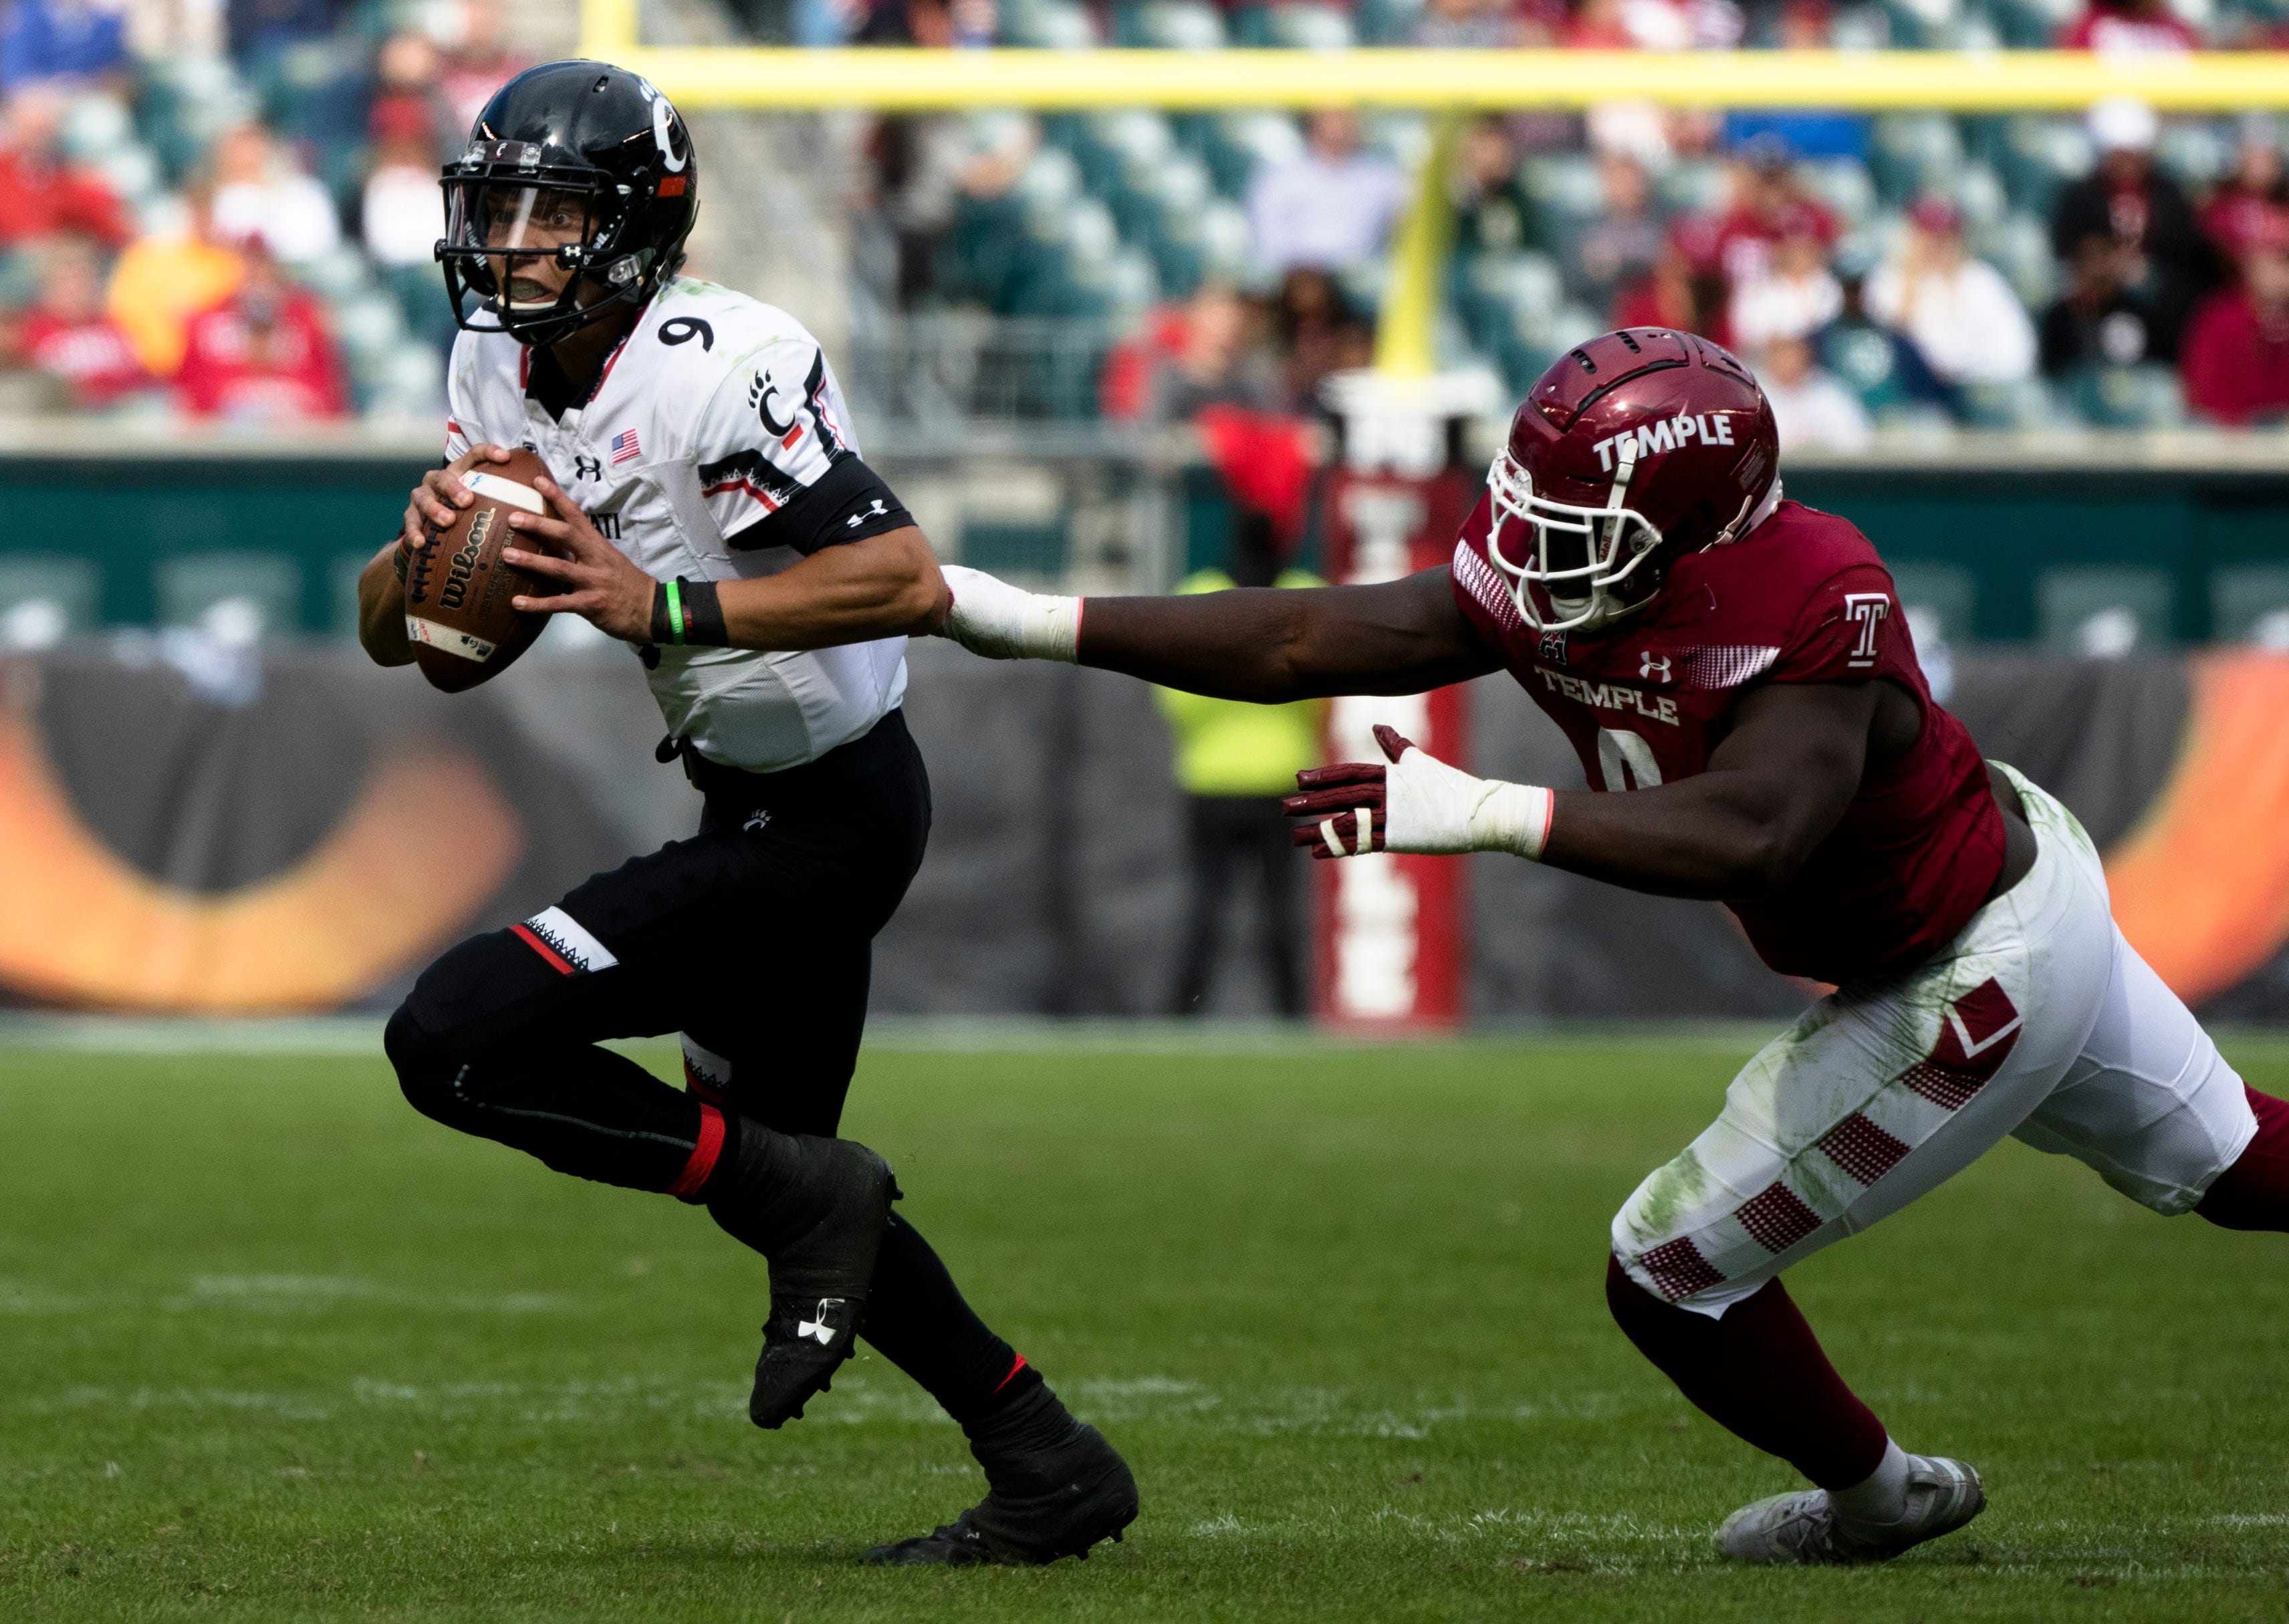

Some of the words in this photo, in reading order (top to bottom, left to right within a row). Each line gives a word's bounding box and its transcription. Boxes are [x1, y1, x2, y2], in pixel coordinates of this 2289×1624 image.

[658, 316, 714, 354] 9
[1592, 414, 1735, 472] TEMPLE
[438, 509, 495, 611] Wilson
[1844, 593, 1891, 667] T
[1534, 665, 1679, 726] TEMPLE
